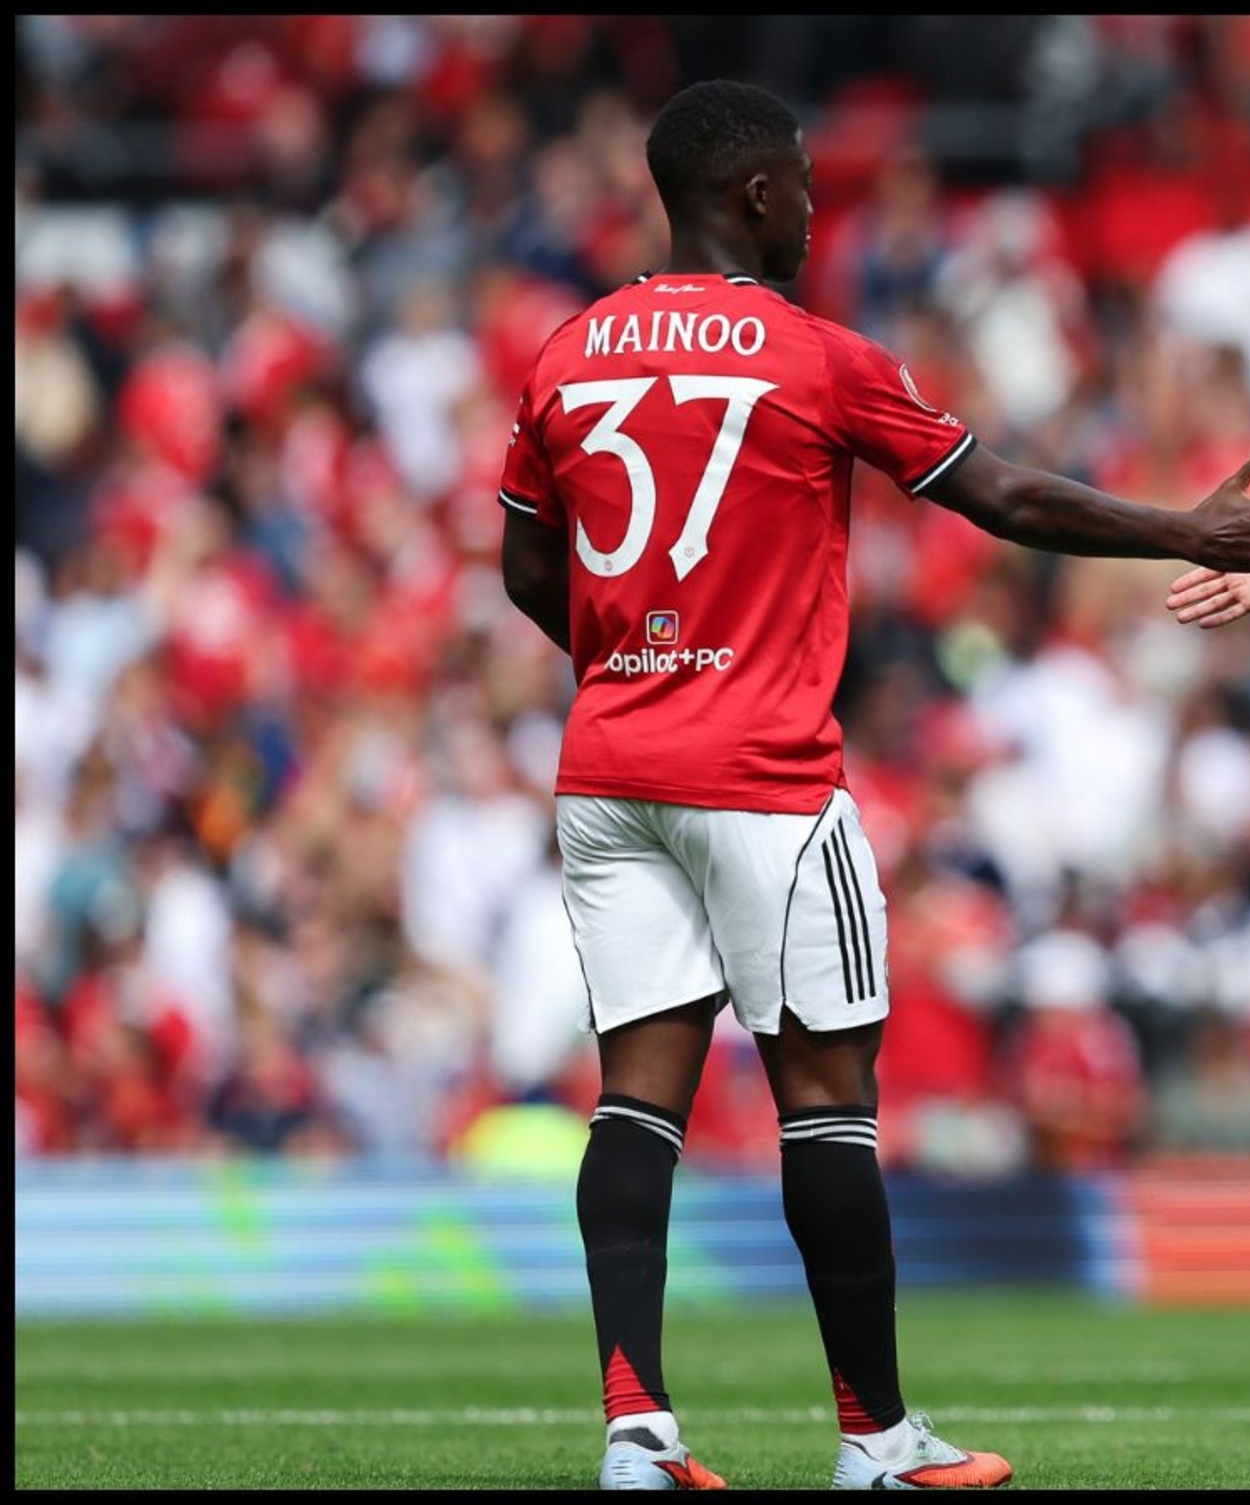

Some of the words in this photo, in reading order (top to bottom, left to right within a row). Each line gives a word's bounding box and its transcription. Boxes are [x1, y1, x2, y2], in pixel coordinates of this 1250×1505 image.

[584, 310, 766, 359] MAINOO
[556, 374, 780, 582] 37
[606, 648, 734, 677] opilot+PC
